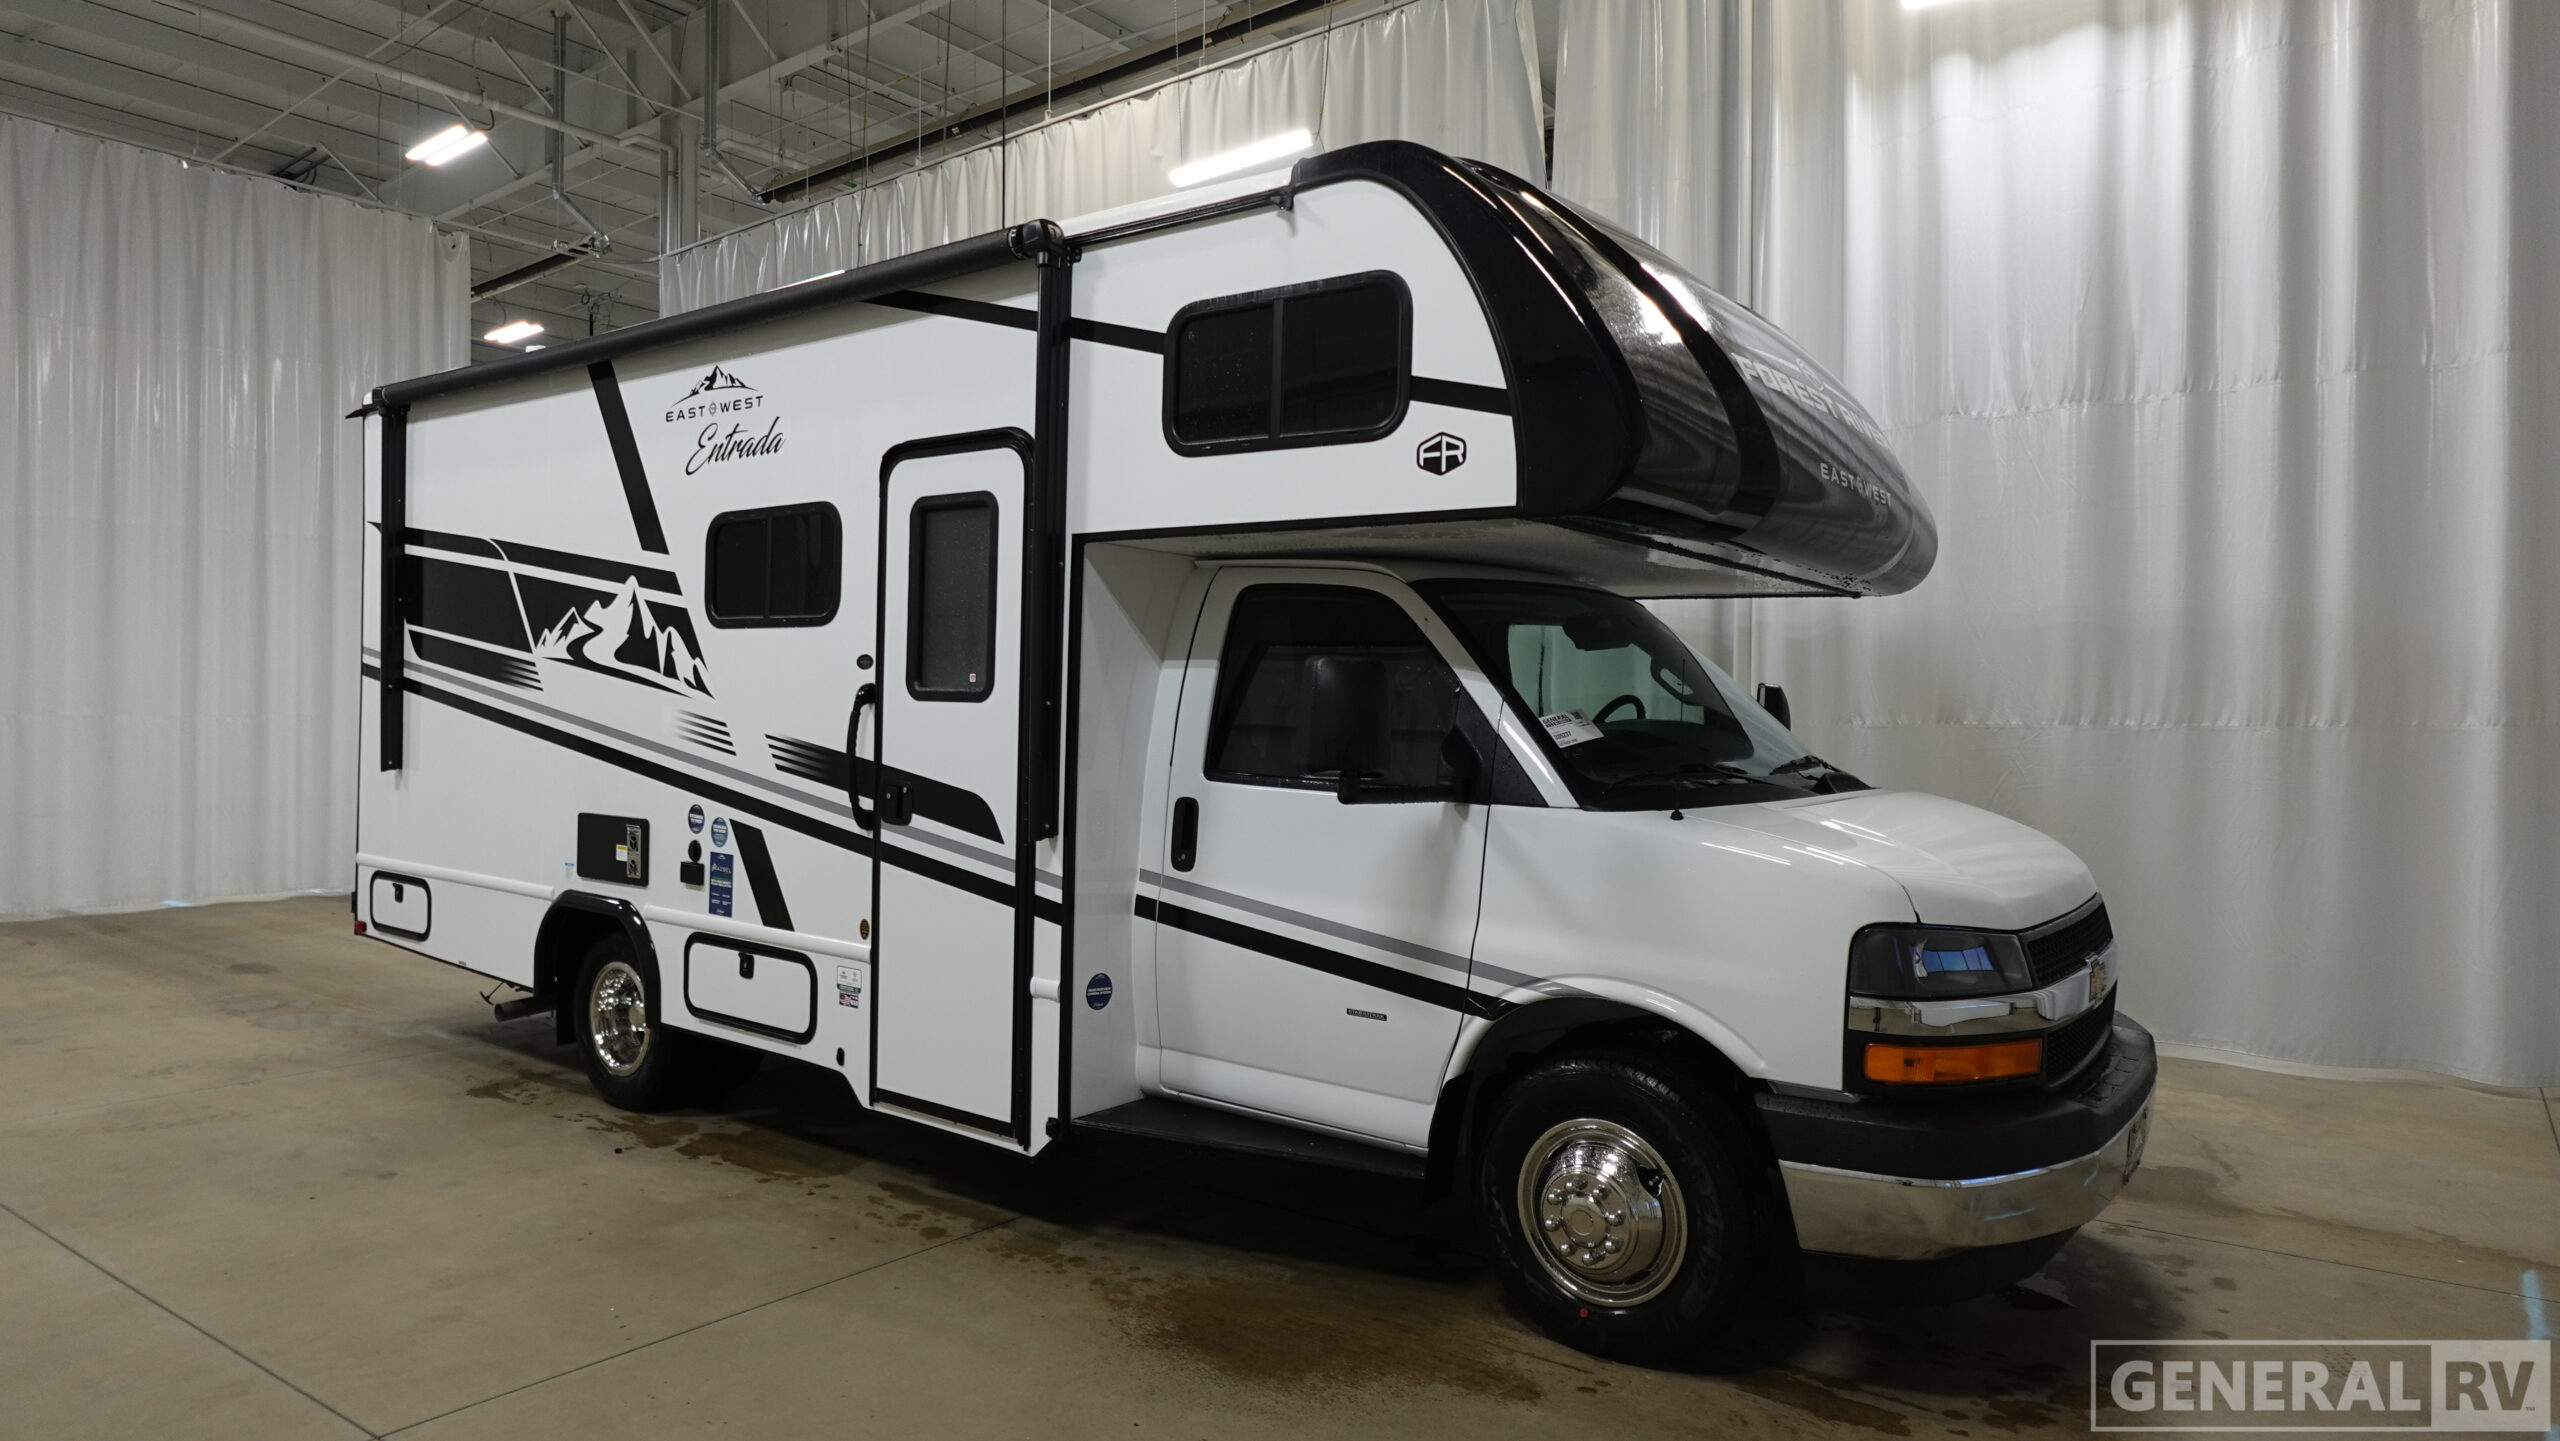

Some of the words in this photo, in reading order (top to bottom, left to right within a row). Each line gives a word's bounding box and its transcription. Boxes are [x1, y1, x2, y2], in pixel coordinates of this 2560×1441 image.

[665, 405, 706, 423] EAST
[720, 395, 764, 413] WEST
[1731, 352, 1838, 419] FOREST
[1835, 401, 1892, 451] RIVE
[685, 416, 787, 476] Entrada
[1418, 434, 1464, 473] FR
[1820, 462, 1854, 490] EAST
[1864, 480, 1892, 506] WEST
